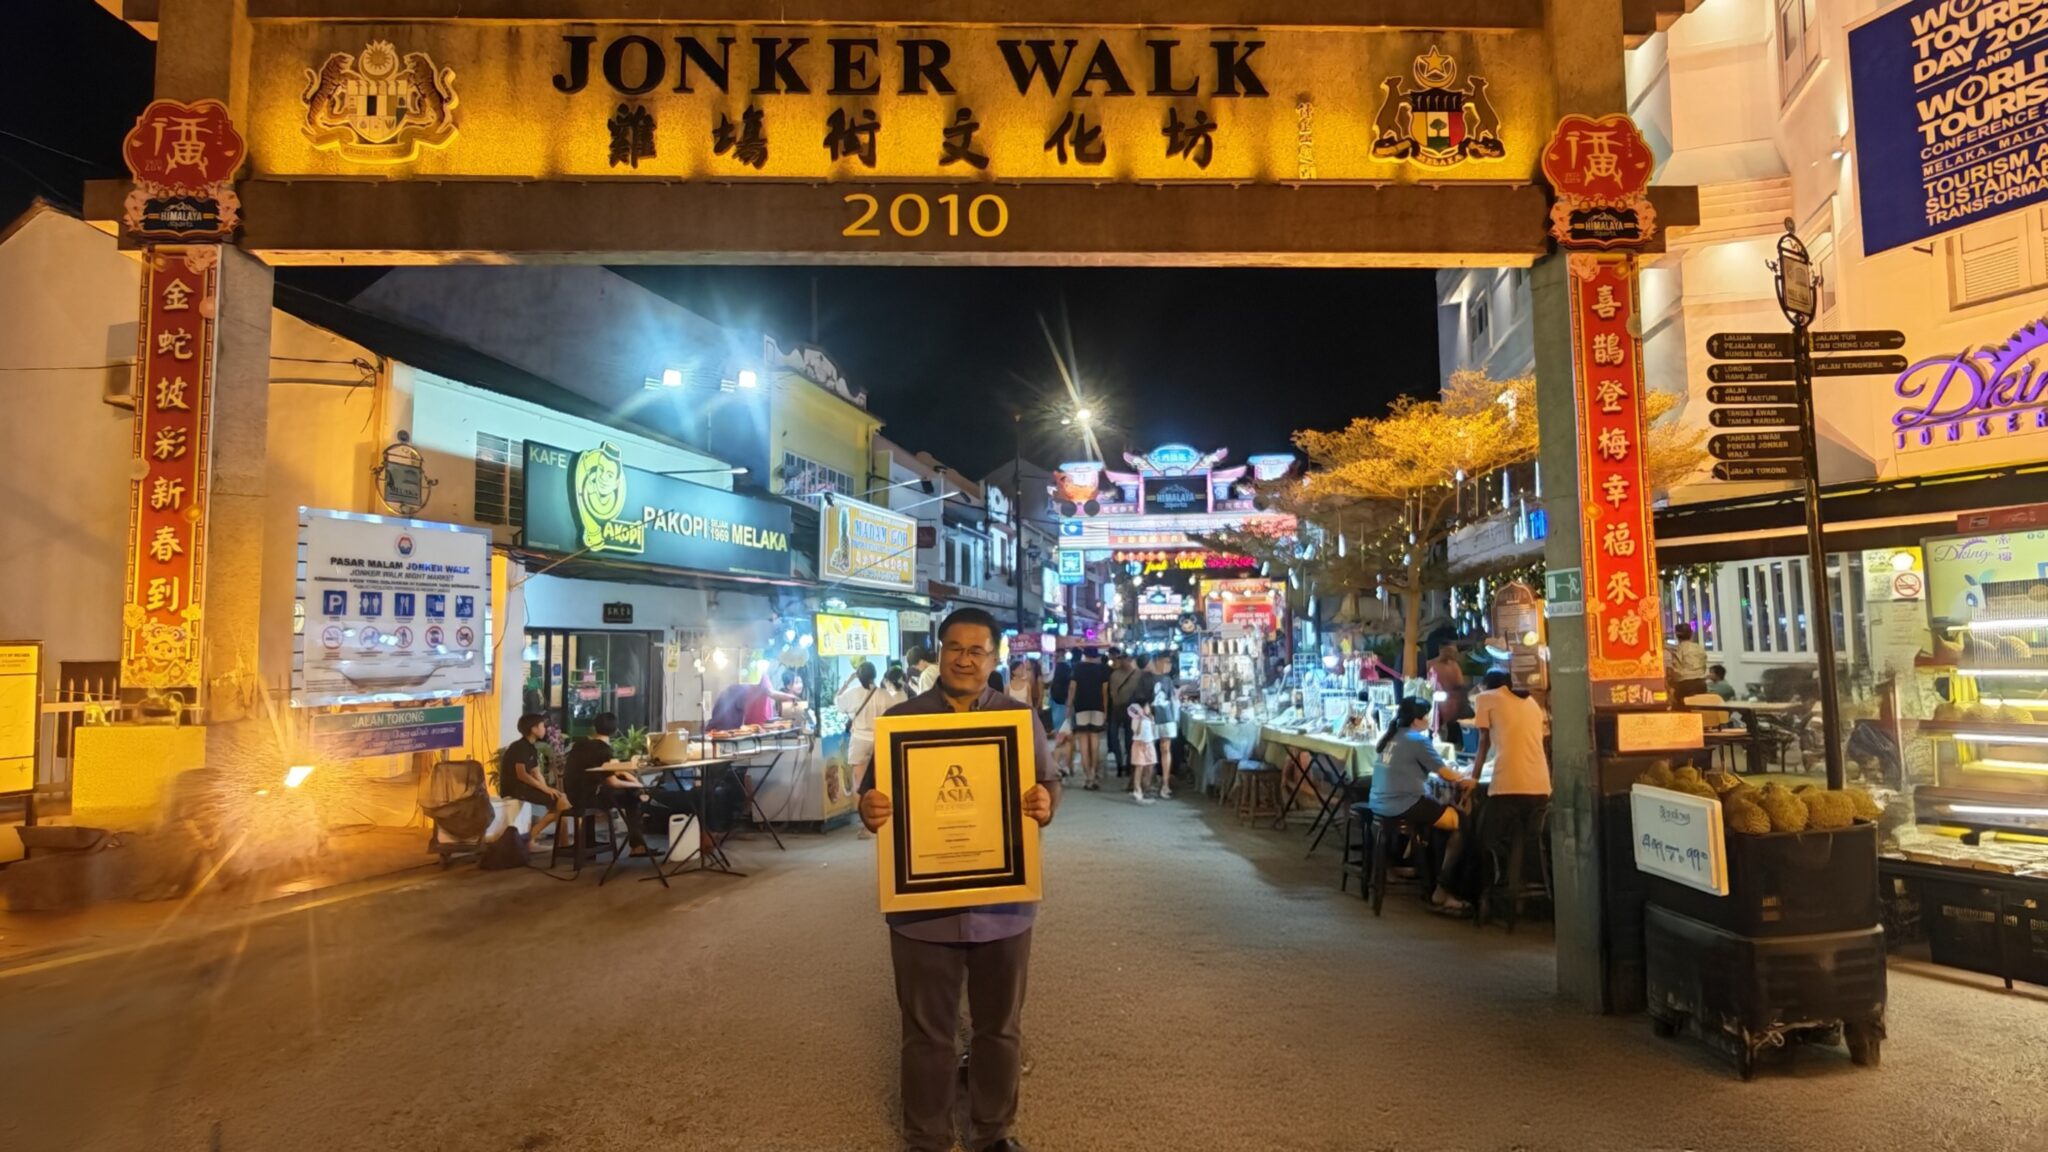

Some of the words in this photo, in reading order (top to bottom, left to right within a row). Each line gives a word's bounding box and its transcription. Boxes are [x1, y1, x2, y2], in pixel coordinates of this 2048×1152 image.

[1912, 0, 2048, 59] TOURIS
[552, 35, 957, 95] JONKER
[997, 39, 1269, 98] WALK
[1913, 37, 1979, 85] DAY
[1976, 47, 2012, 71] AND
[1921, 105, 2040, 160] CONFERENCE
[1923, 147, 1993, 177] MELAKA,
[1999, 123, 2048, 150] MALA
[1924, 149, 2030, 199] TOURISM
[160, 211, 202, 221] HIMALAYA
[842, 193, 1008, 237] 2010
[1585, 221, 1624, 231] HIMALAYA
[146, 278, 193, 613] 金蛇披彩新春到
[1896, 406, 2048, 449] JONKER
[529, 446, 567, 469] KAFE
[1156, 492, 1195, 502] HIMALAYA
[643, 505, 707, 539] PAKOPI
[731, 523, 788, 552] MELAKA
[330, 557, 365, 567] PASAR
[368, 560, 403, 570] MALAM
[406, 563, 443, 573] JONKER
[445, 565, 470, 575] WALK
[350, 570, 380, 578] JONKER
[382, 571, 403, 579] WALK
[427, 574, 455, 582] MARKET
[352, 714, 384, 728] JALAN
[386, 711, 425, 725] TOKONG
[936, 789, 976, 803] ASIA
